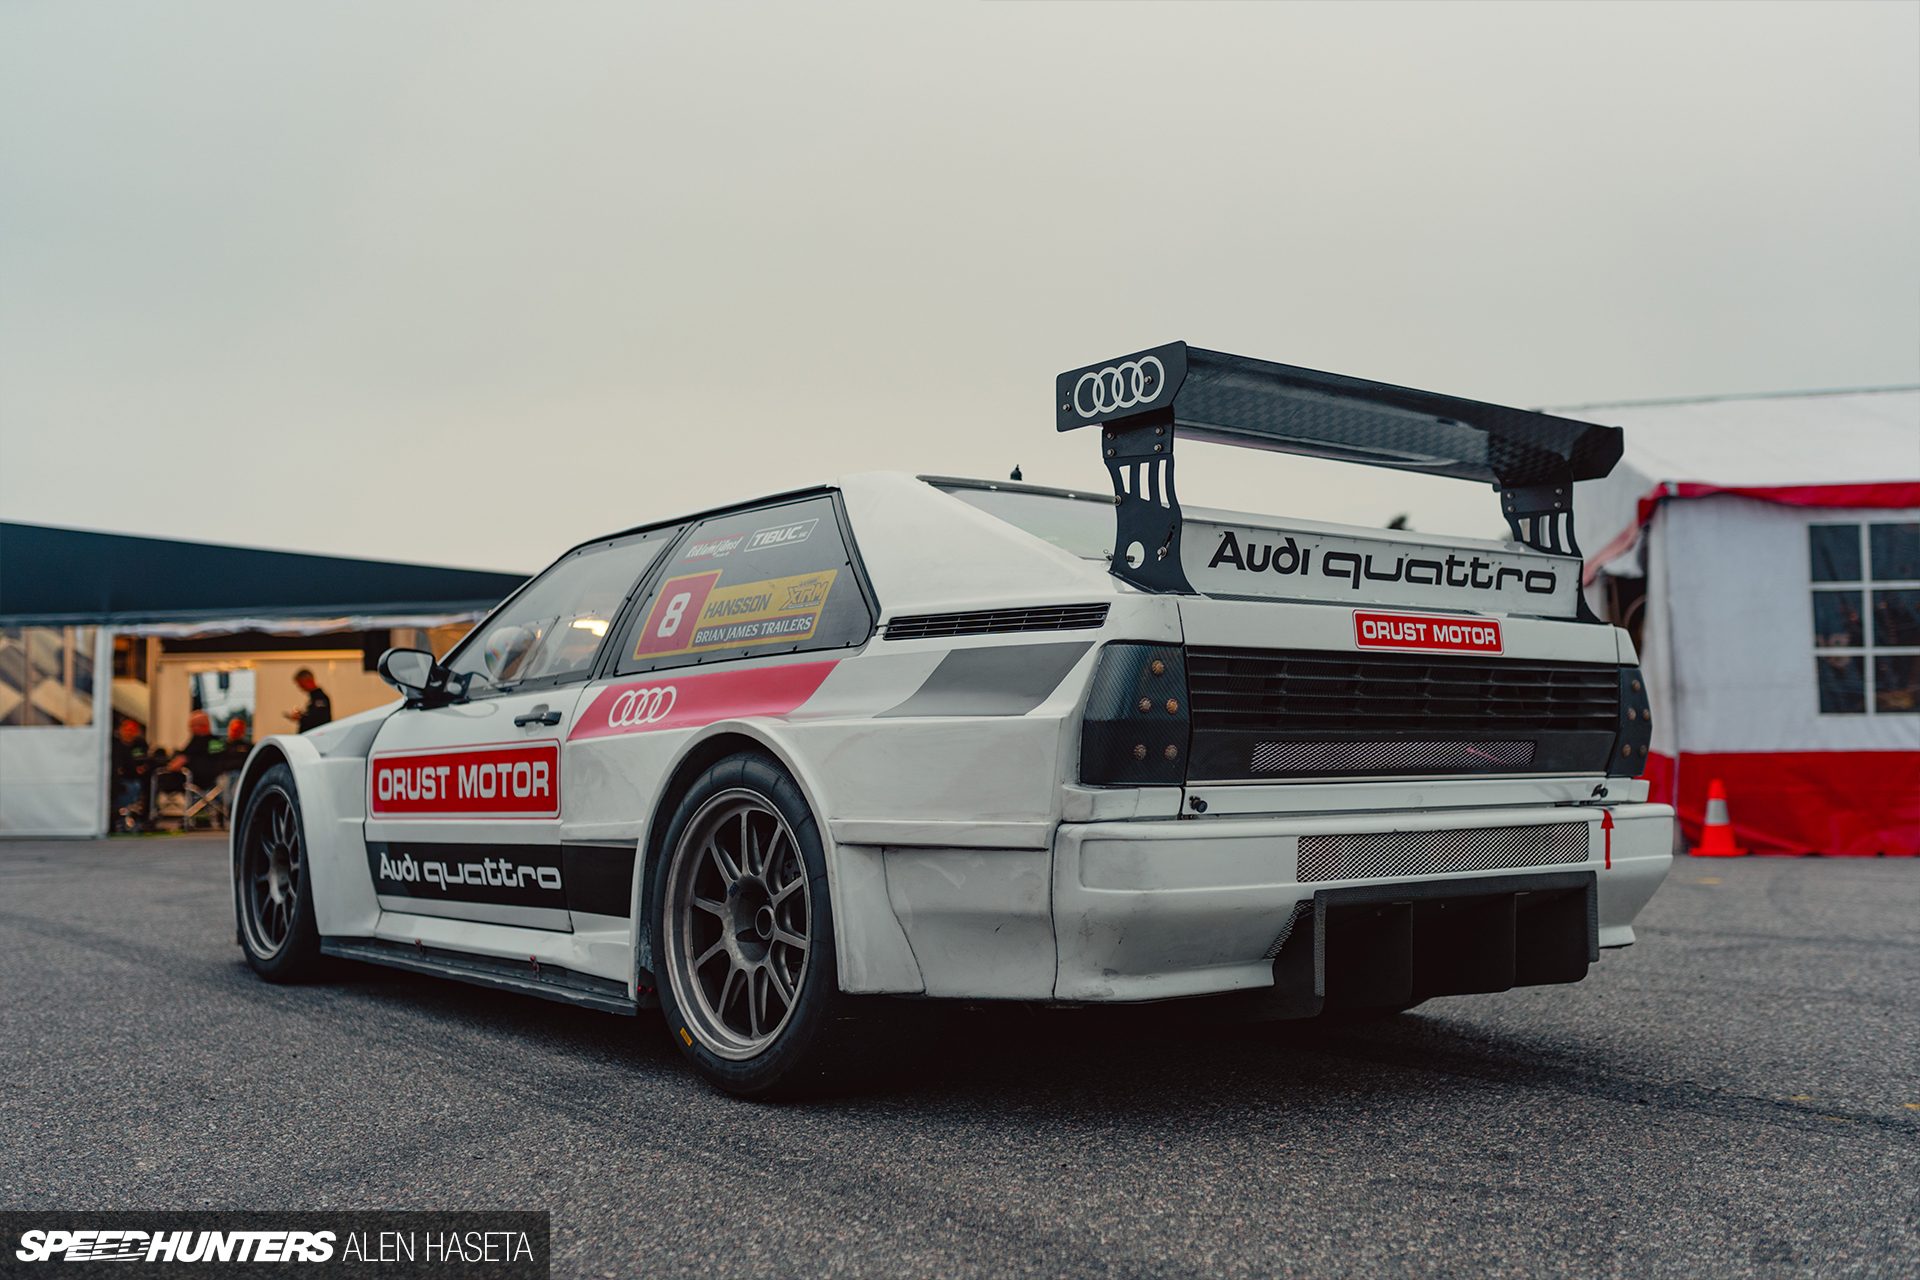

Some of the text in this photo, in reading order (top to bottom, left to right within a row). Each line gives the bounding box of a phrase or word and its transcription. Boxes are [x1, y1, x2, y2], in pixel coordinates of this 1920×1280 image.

[752, 525, 803, 547] TIBUC
[1207, 531, 1557, 595] Audi quattro
[703, 593, 773, 619] HANSSON
[778, 581, 830, 611] XTRM
[657, 592, 692, 638] 8
[694, 616, 813, 644] BRIAN JAMES TRAILERS
[1362, 620, 1497, 646] ORUST MOTOR
[378, 761, 550, 801] ORUST MOTOR
[379, 852, 562, 892] Audi quattro
